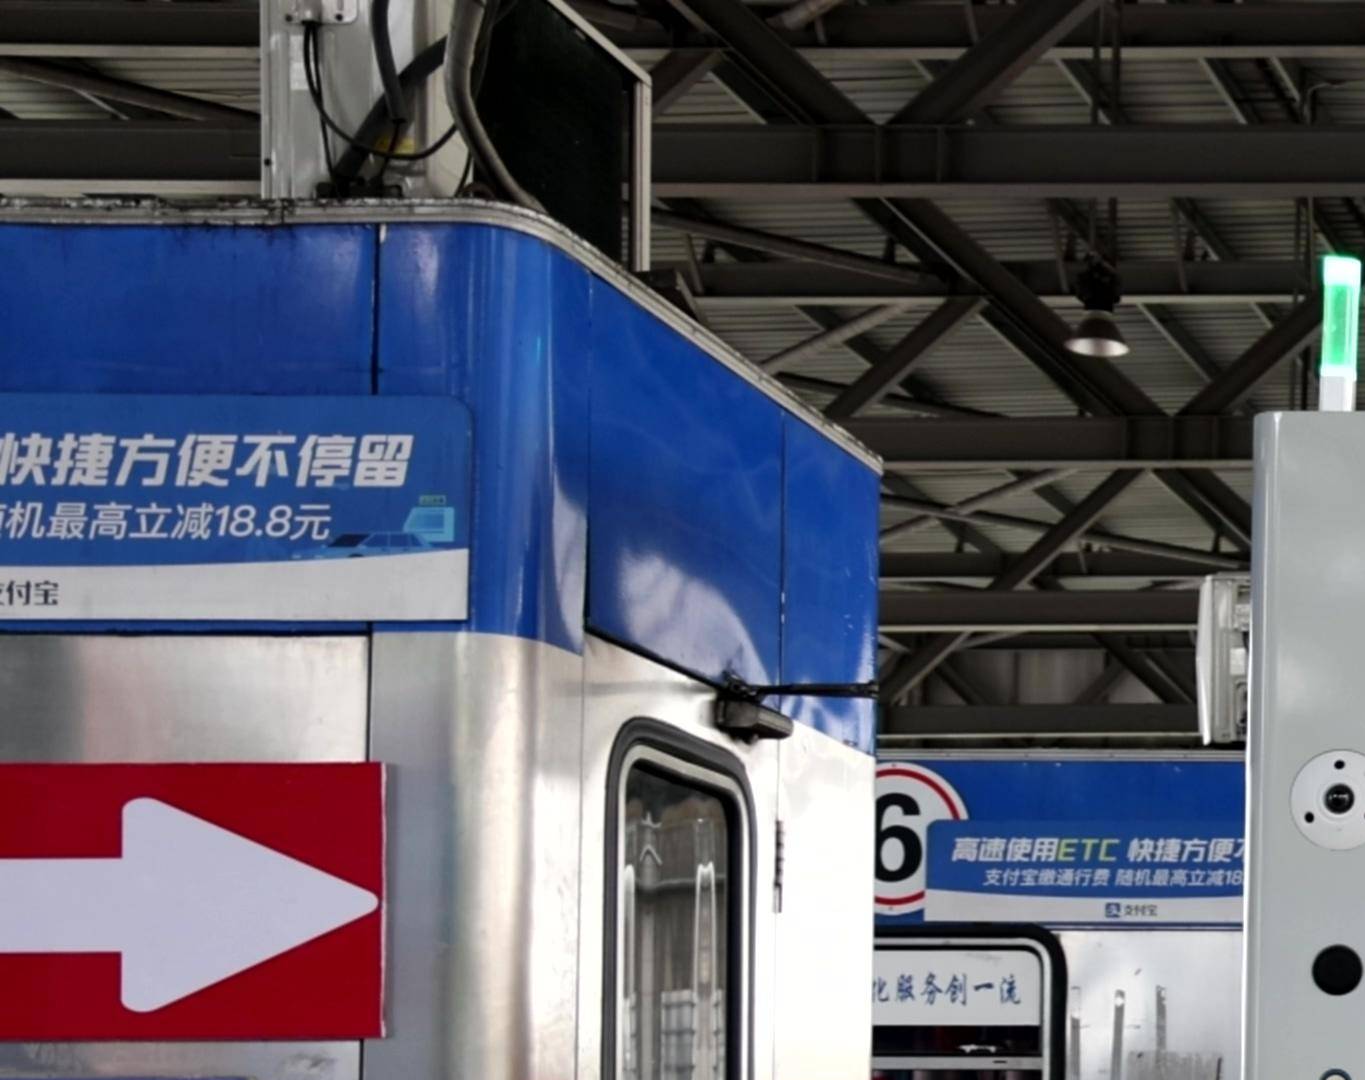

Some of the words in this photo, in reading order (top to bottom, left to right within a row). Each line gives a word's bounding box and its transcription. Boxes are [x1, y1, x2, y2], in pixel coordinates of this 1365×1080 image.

[0, 432, 414, 488] 快捷方便不停留
[0, 502, 332, 541] 机最高立减18.8元
[0, 580, 59, 606] 付宝
[874, 792, 923, 883] 6
[952, 836, 1120, 863] 高速使用ETC
